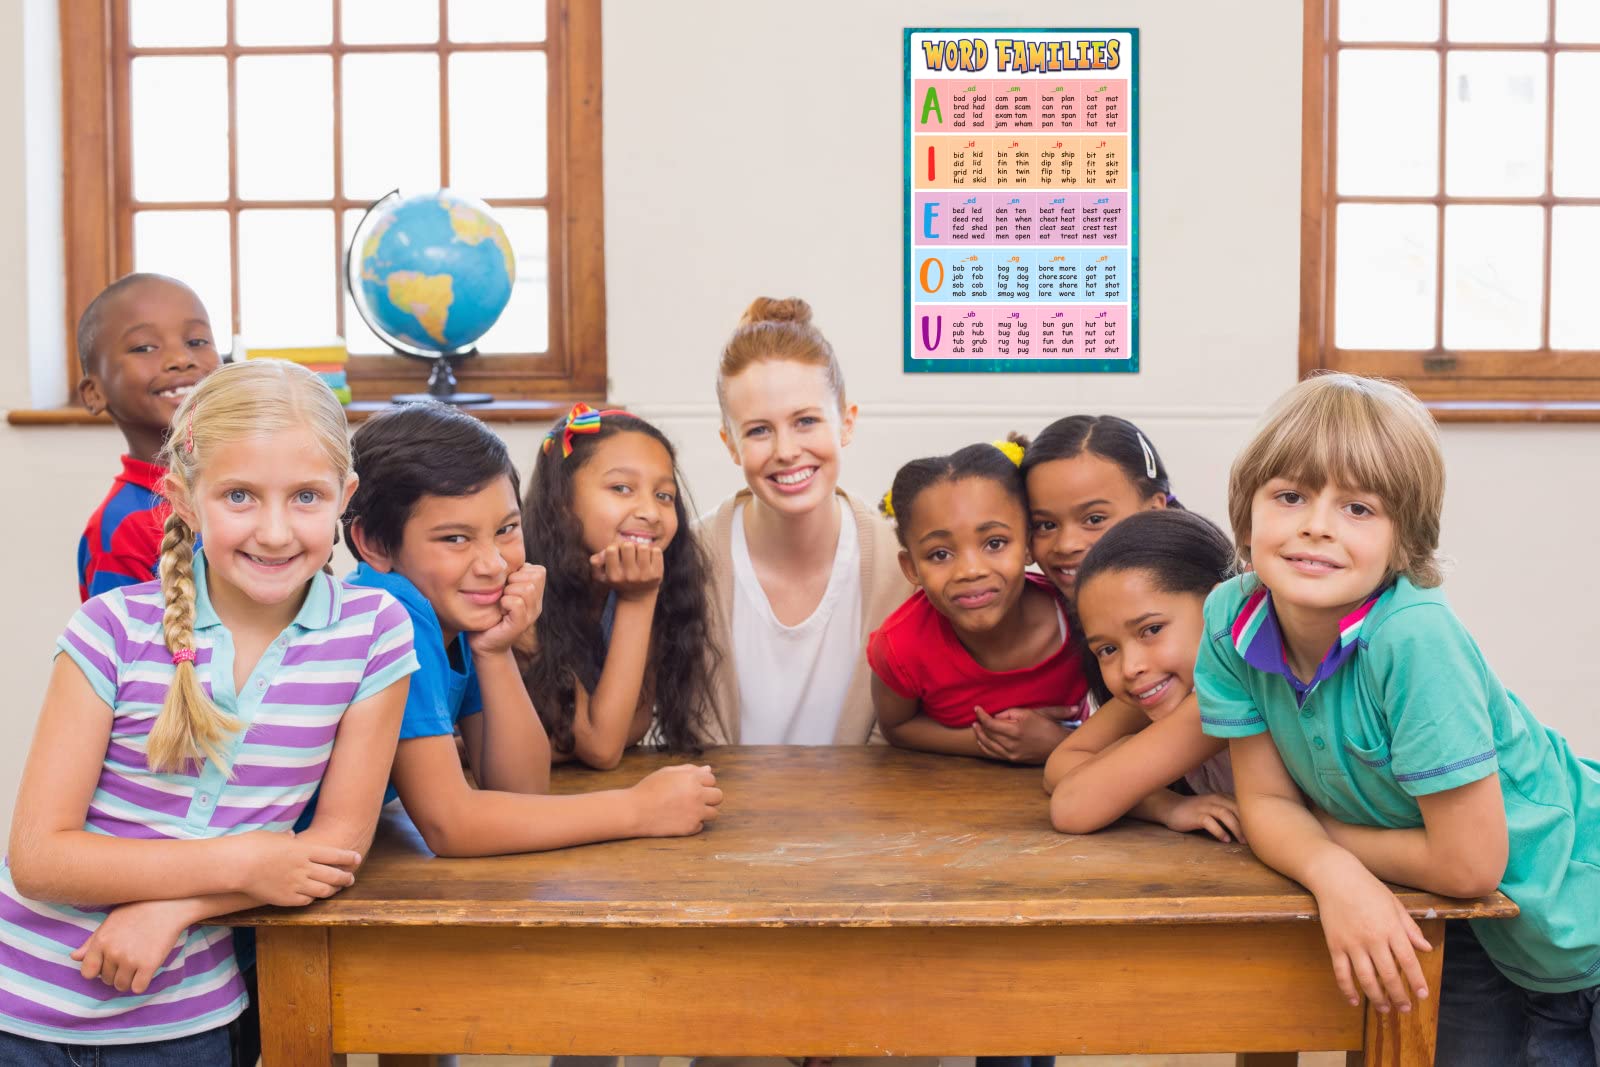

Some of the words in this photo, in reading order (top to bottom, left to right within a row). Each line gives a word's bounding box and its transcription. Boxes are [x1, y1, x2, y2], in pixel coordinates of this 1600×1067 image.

[922, 39, 988, 72] WORD
[995, 39, 1120, 73] FAMILIES
[972, 94, 987, 104] glad
[1061, 95, 1075, 103] plan
[921, 86, 943, 124] A
[1041, 151, 1055, 159] chip
[1061, 151, 1075, 159] ship
[1041, 159, 1052, 167] dip
[1061, 159, 1073, 168] slip
[953, 169, 967, 178] grid
[1041, 167, 1053, 176] flip
[1041, 176, 1052, 184] hip
[924, 203, 940, 238] E
[997, 265, 1010, 274] bog
[920, 258, 944, 293] O
[952, 273, 964, 282] job
[998, 273, 1009, 282] fog
[1017, 273, 1029, 282] dog
[997, 281, 1008, 290] log
[1017, 282, 1029, 290] hog
[1017, 320, 1028, 330] lug
[922, 316, 941, 351] U
[998, 329, 1011, 338] bug
[1017, 330, 1030, 338] dug
[971, 338, 988, 346] grub
[1017, 337, 1030, 346] hug
